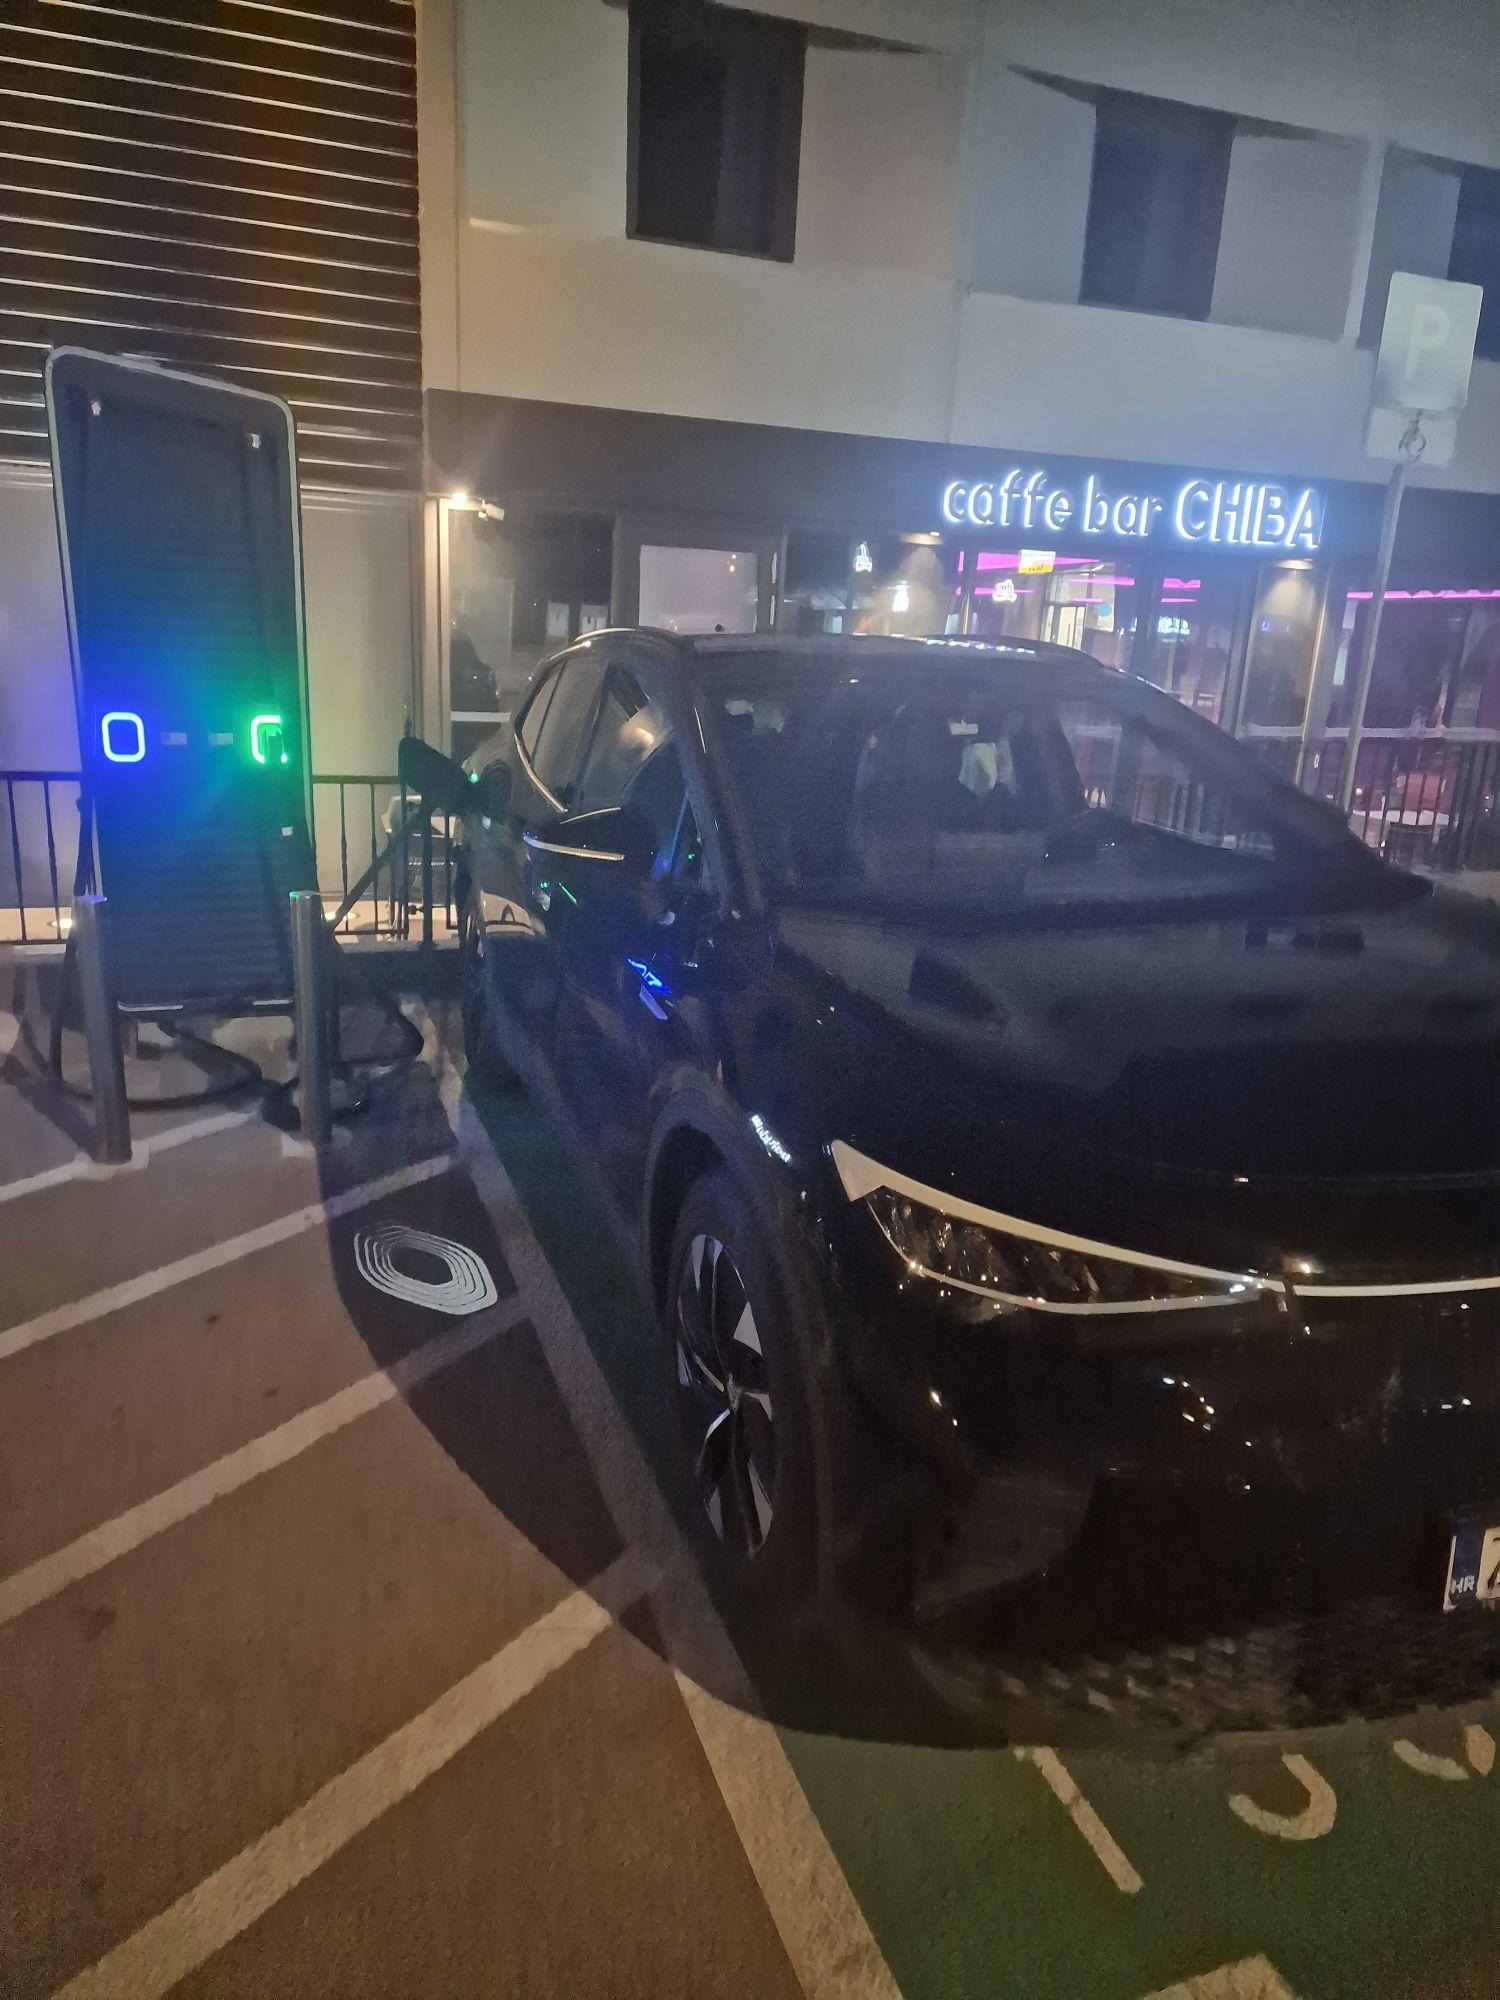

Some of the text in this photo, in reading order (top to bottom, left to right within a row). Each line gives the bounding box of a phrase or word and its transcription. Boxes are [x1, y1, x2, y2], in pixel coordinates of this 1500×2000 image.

[1406, 304, 1450, 380] P
[942, 469, 1321, 549] caffe bar CHIBA
[1451, 1575, 1475, 1594] HR
